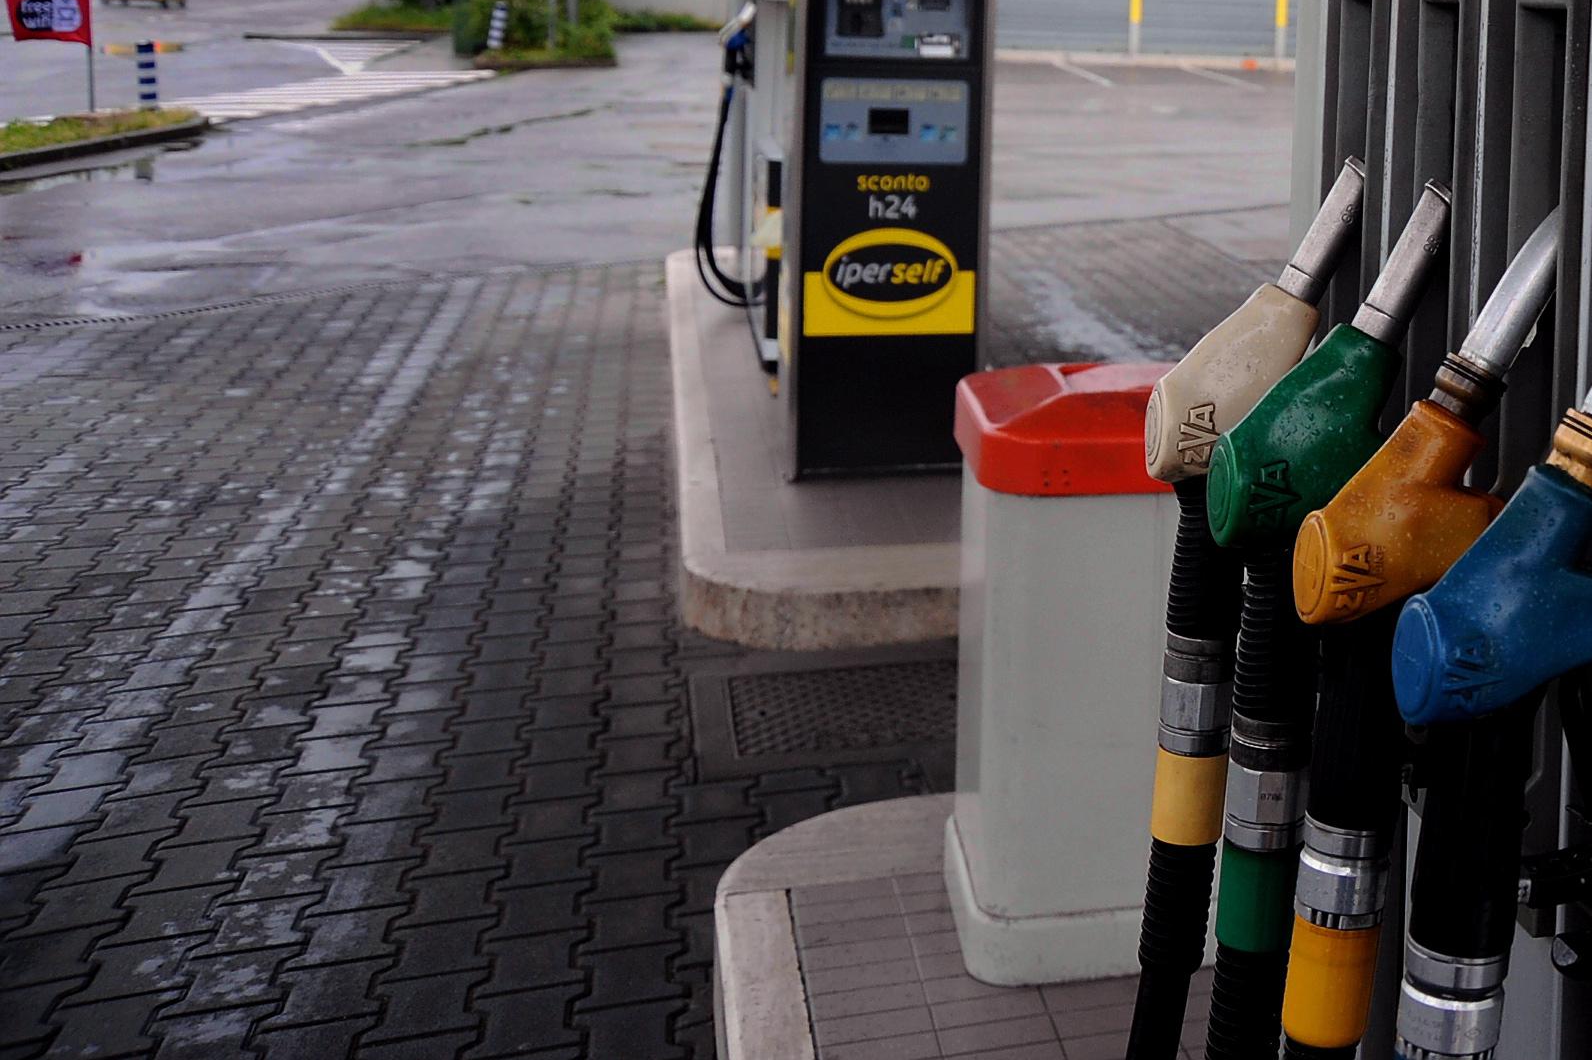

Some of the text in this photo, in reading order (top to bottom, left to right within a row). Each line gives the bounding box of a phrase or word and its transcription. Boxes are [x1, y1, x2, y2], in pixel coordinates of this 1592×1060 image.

[857, 173, 930, 192] sconto
[868, 194, 918, 219] h24
[835, 255, 947, 289] iperself
